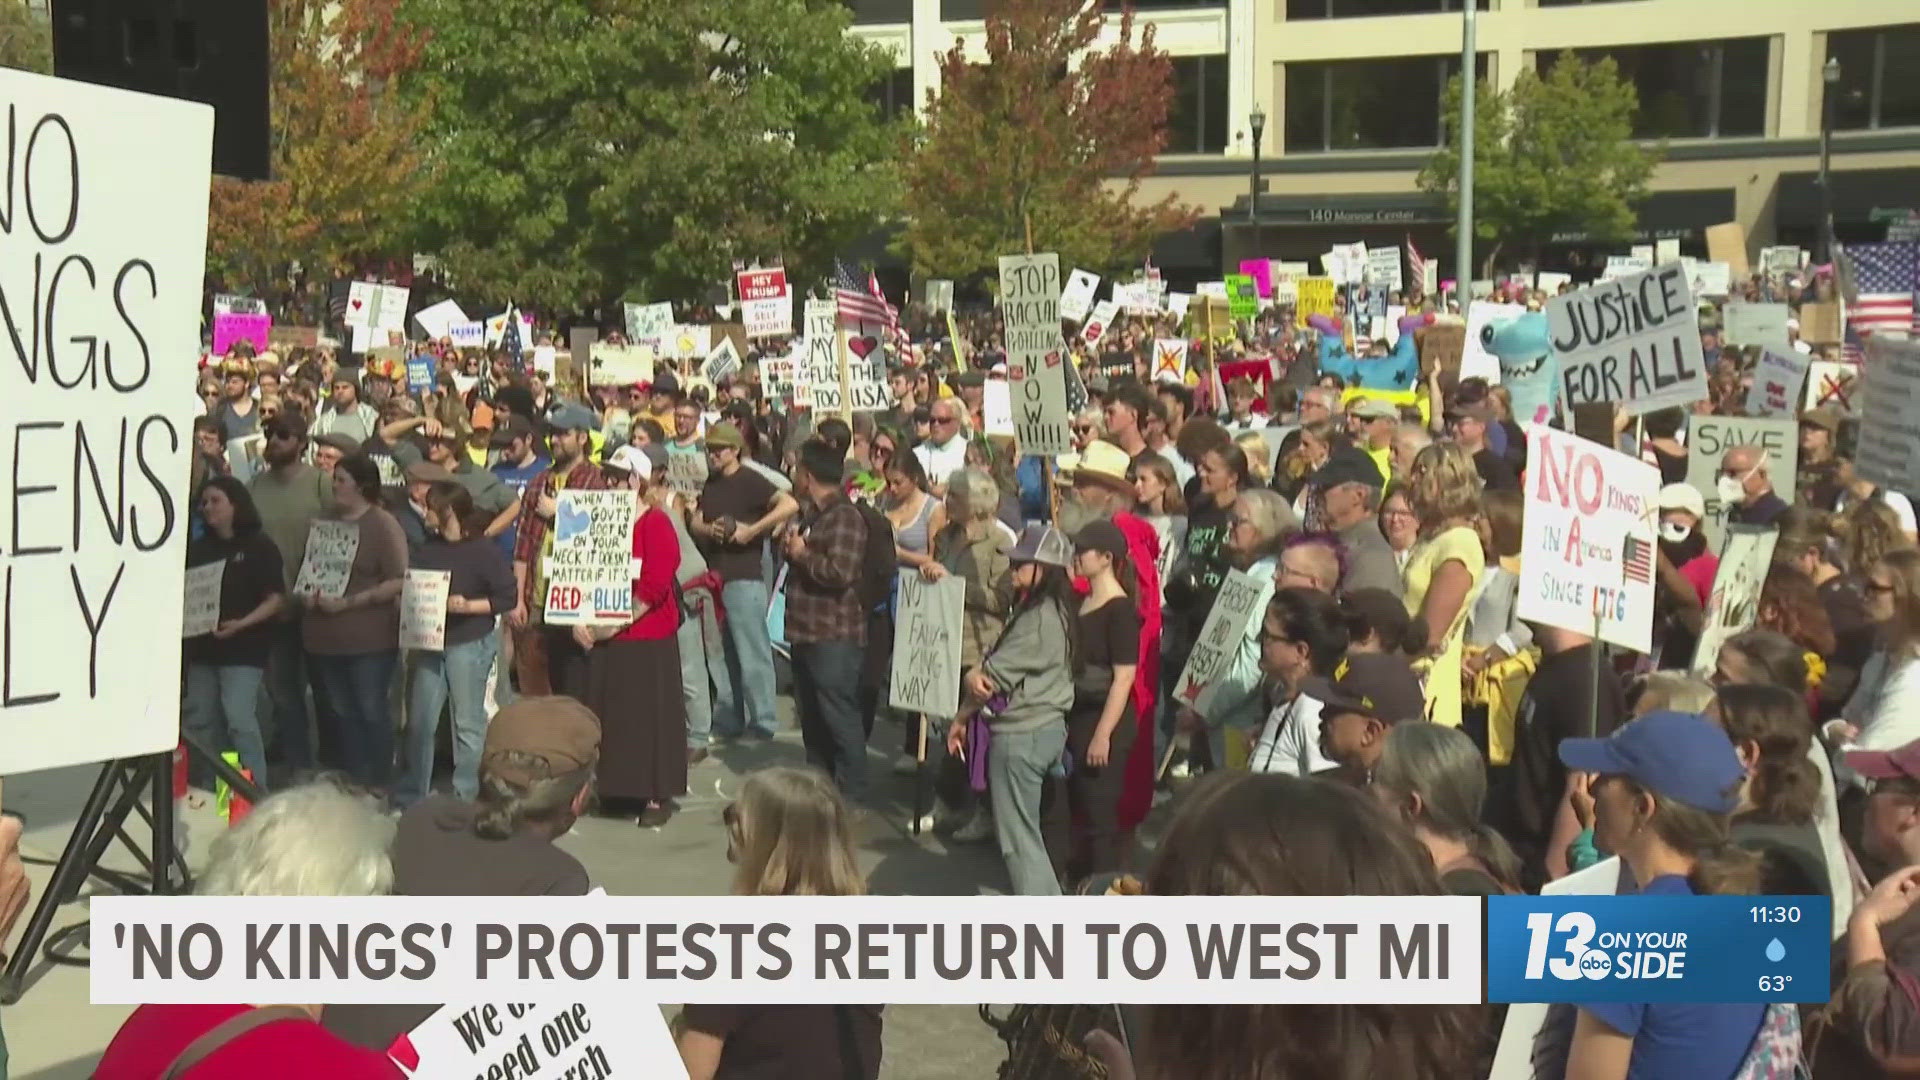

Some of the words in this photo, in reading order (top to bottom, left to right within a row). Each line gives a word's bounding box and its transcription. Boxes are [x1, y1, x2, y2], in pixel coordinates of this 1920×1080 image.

[1310, 209, 1332, 222] 140
[1376, 209, 1415, 221] Center
[746, 286, 780, 299] TRUMP
[752, 274, 772, 287] HEY
[1004, 263, 1056, 298] STOP
[1004, 299, 1057, 328] RACIAL
[811, 335, 834, 363] MY
[849, 363, 883, 381] THE
[1564, 356, 1622, 411] FOR
[1629, 337, 1696, 399] ALL
[813, 389, 841, 409] TOO
[850, 383, 889, 408] USA
[1698, 424, 1784, 458] SAVE
[1537, 434, 1604, 516] NO
[1607, 484, 1641, 515] KINGS
[573, 493, 604, 506] WHEN
[611, 493, 629, 505] THE
[573, 535, 587, 548] ON
[592, 535, 620, 549] YOUR
[618, 523, 628, 538] IS
[1542, 525, 1561, 552] IN
[553, 549, 582, 565] NECK
[587, 549, 596, 564] IT
[552, 566, 593, 582] MATTER
[550, 585, 581, 611] RED
[594, 587, 632, 611] BLUE
[901, 575, 923, 609] NO
[1541, 571, 1583, 606] SINCE
[1593, 585, 1626, 622] 1776
[896, 670, 930, 707] WAY
[452, 1003, 503, 1056] We
[541, 1003, 592, 1057] one
